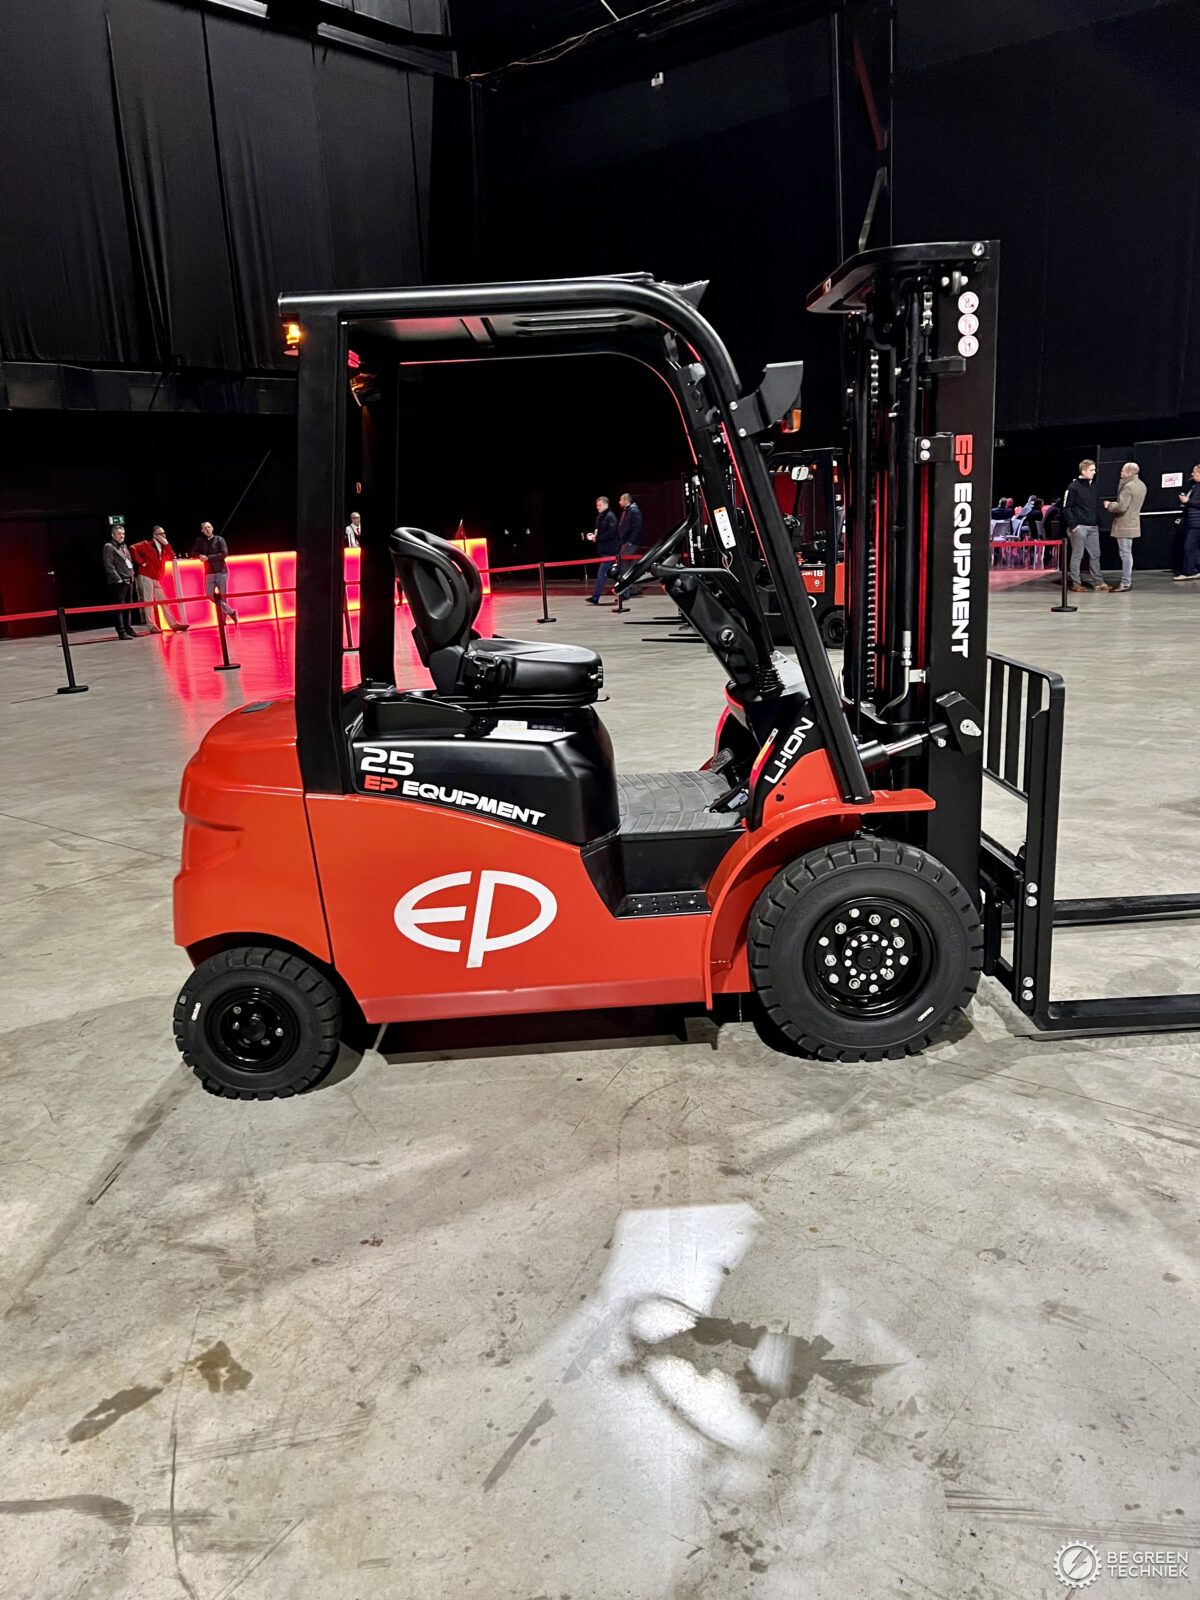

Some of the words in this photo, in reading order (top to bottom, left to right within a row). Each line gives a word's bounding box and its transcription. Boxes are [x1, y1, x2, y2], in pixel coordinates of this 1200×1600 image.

[955, 434, 973, 476] EP
[951, 482, 973, 659] EQUIPMENT
[360, 747, 415, 776] 25
[364, 774, 399, 792] EP
[402, 780, 547, 826] EQUIPMENT
[393, 869, 558, 968] EP
